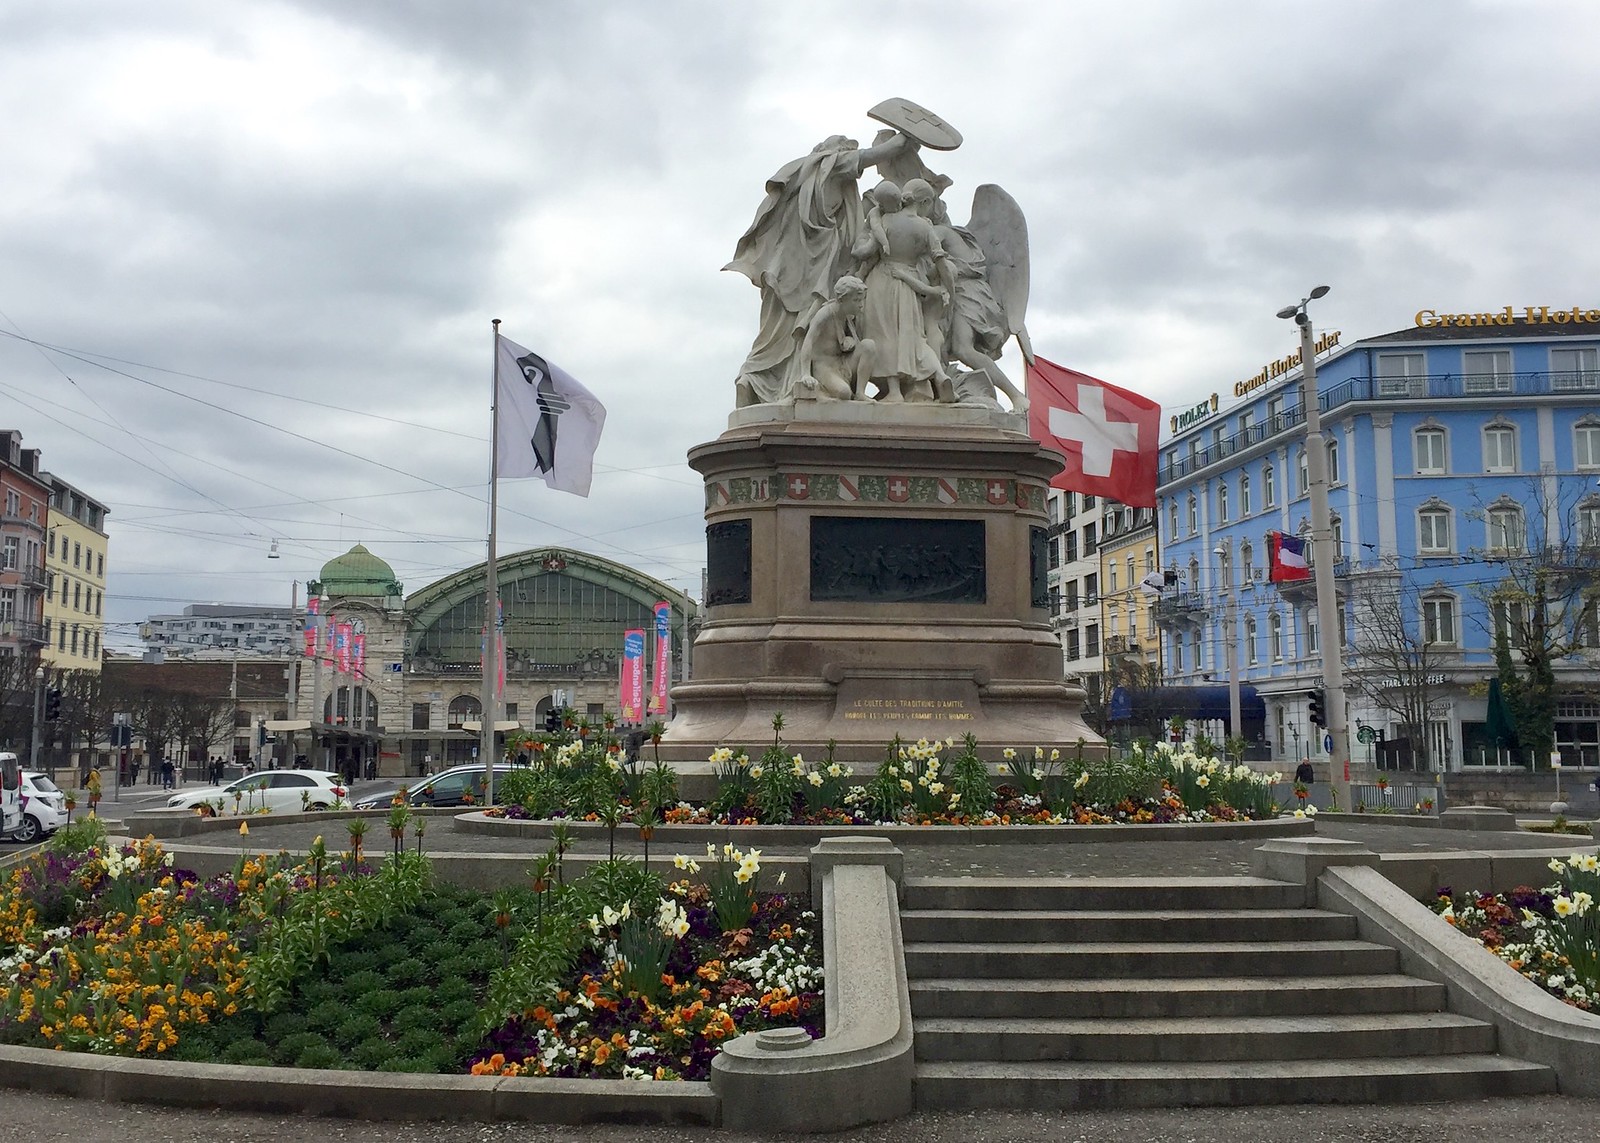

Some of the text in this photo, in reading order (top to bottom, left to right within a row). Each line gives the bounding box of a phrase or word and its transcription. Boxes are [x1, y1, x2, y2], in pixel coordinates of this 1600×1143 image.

[1415, 306, 1600, 328] Grand Hote
[1233, 331, 1342, 398] Grand Hotel uler
[1179, 400, 1209, 428] ROLEX
